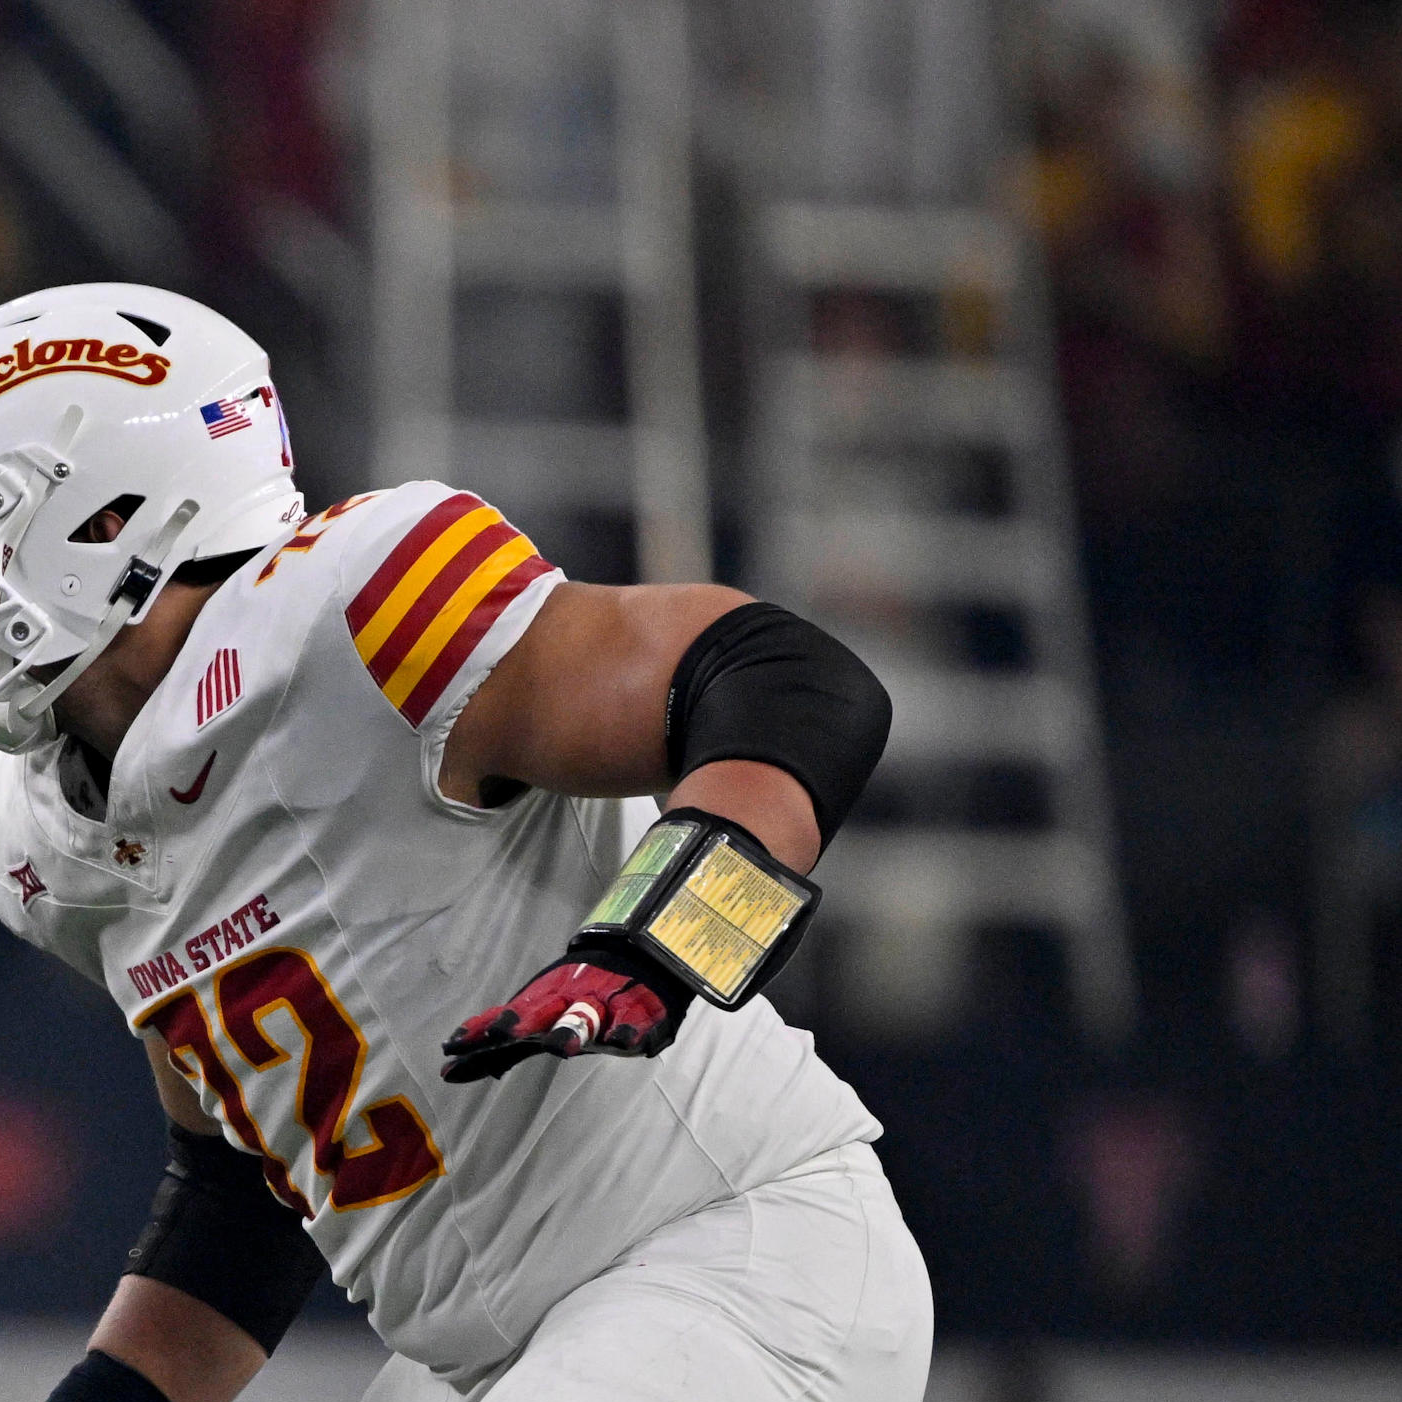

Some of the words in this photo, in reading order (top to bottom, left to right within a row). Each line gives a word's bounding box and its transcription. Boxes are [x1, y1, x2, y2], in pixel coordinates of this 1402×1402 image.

[127, 951, 189, 1000] IOWA
[185, 893, 282, 974] STATE
[133, 946, 448, 1222] 72
